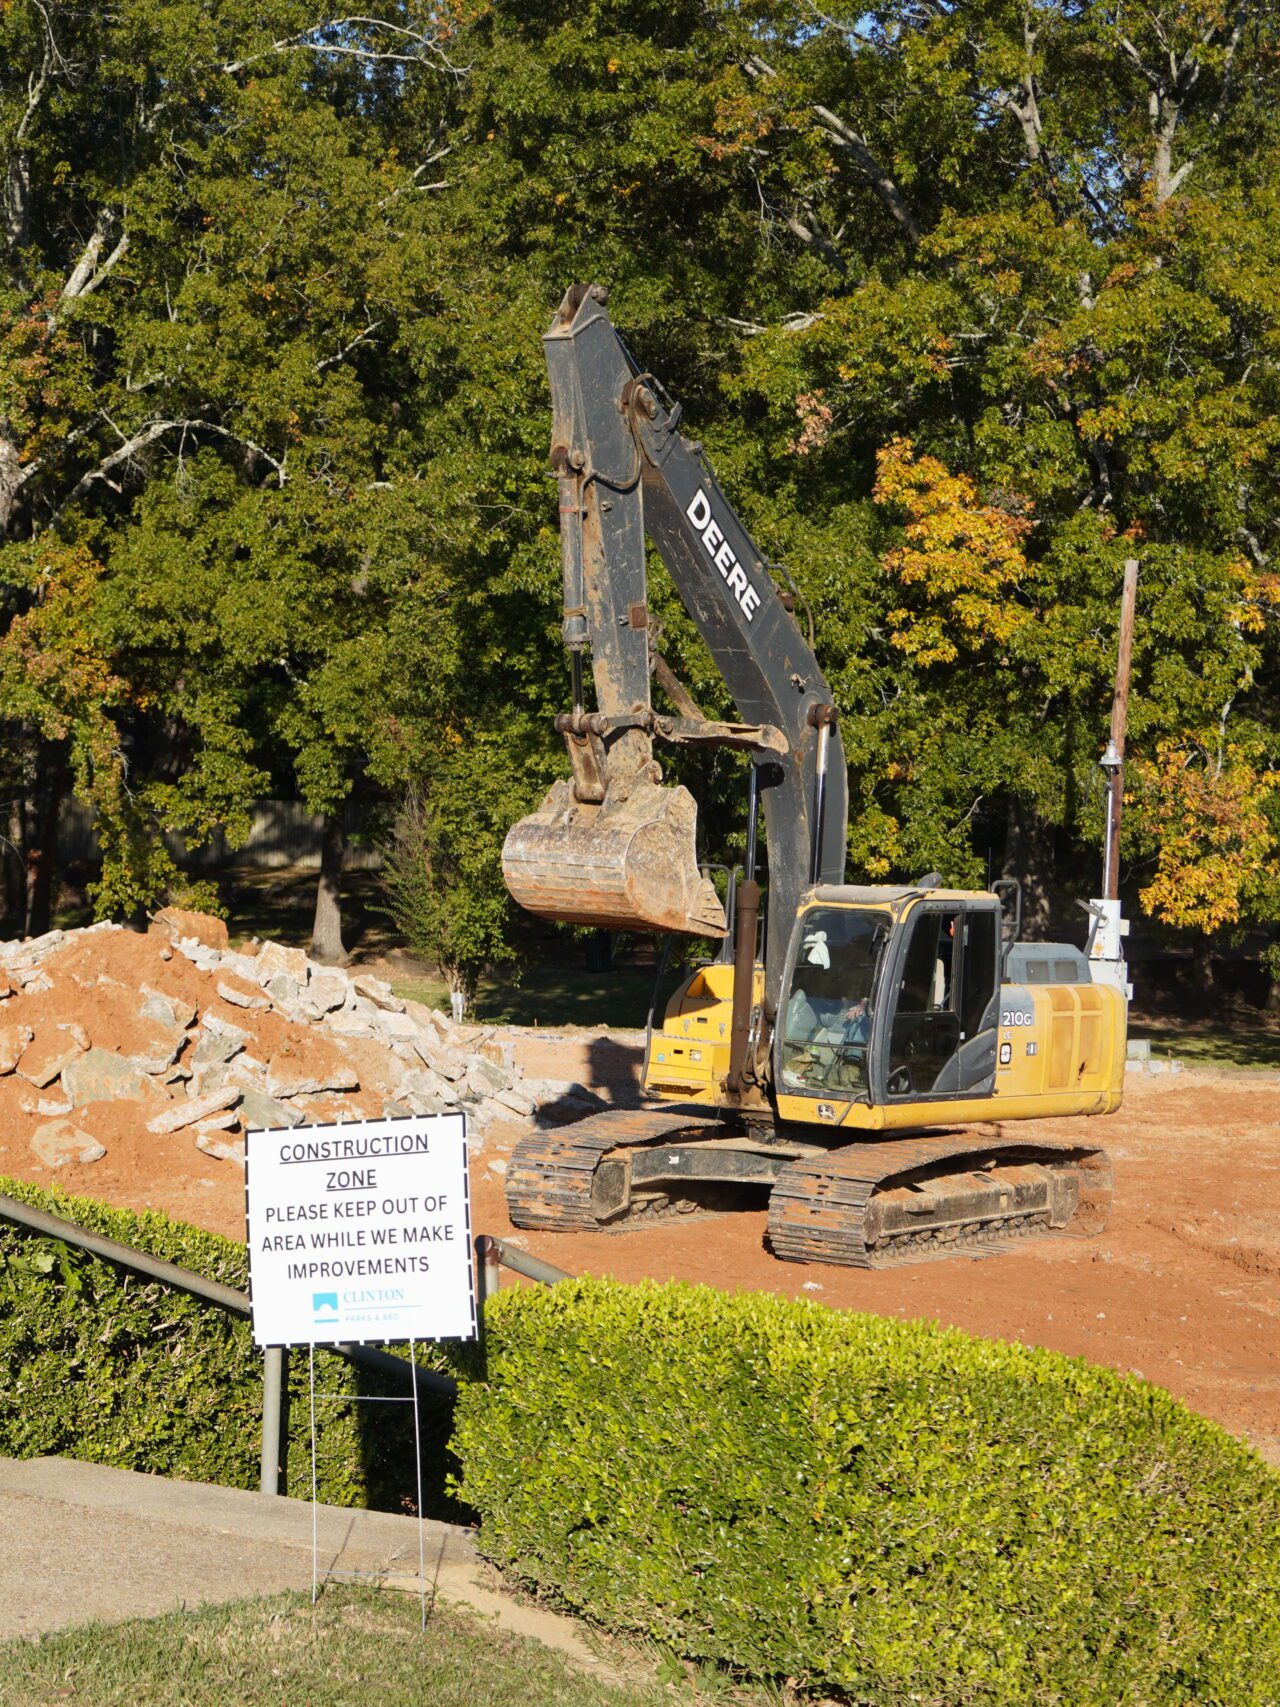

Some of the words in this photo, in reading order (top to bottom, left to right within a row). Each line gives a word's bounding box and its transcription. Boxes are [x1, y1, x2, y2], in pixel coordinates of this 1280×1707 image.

[686, 488, 762, 623] DEERE
[1002, 1010, 1032, 1027] 210G
[280, 1134, 428, 1161] CONSTRUCTION
[326, 1169, 377, 1189] ZONE
[266, 1203, 328, 1222] PLEASE
[334, 1200, 376, 1218] KEEP
[382, 1197, 419, 1215] OUT
[424, 1195, 447, 1212] OF
[262, 1234, 306, 1252] AREA
[311, 1230, 366, 1249] WHILE
[371, 1228, 397, 1245] WE
[403, 1225, 454, 1243] MAKE
[288, 1256, 429, 1279] IMPROVEMENTS
[343, 1288, 405, 1303] CLINTON
